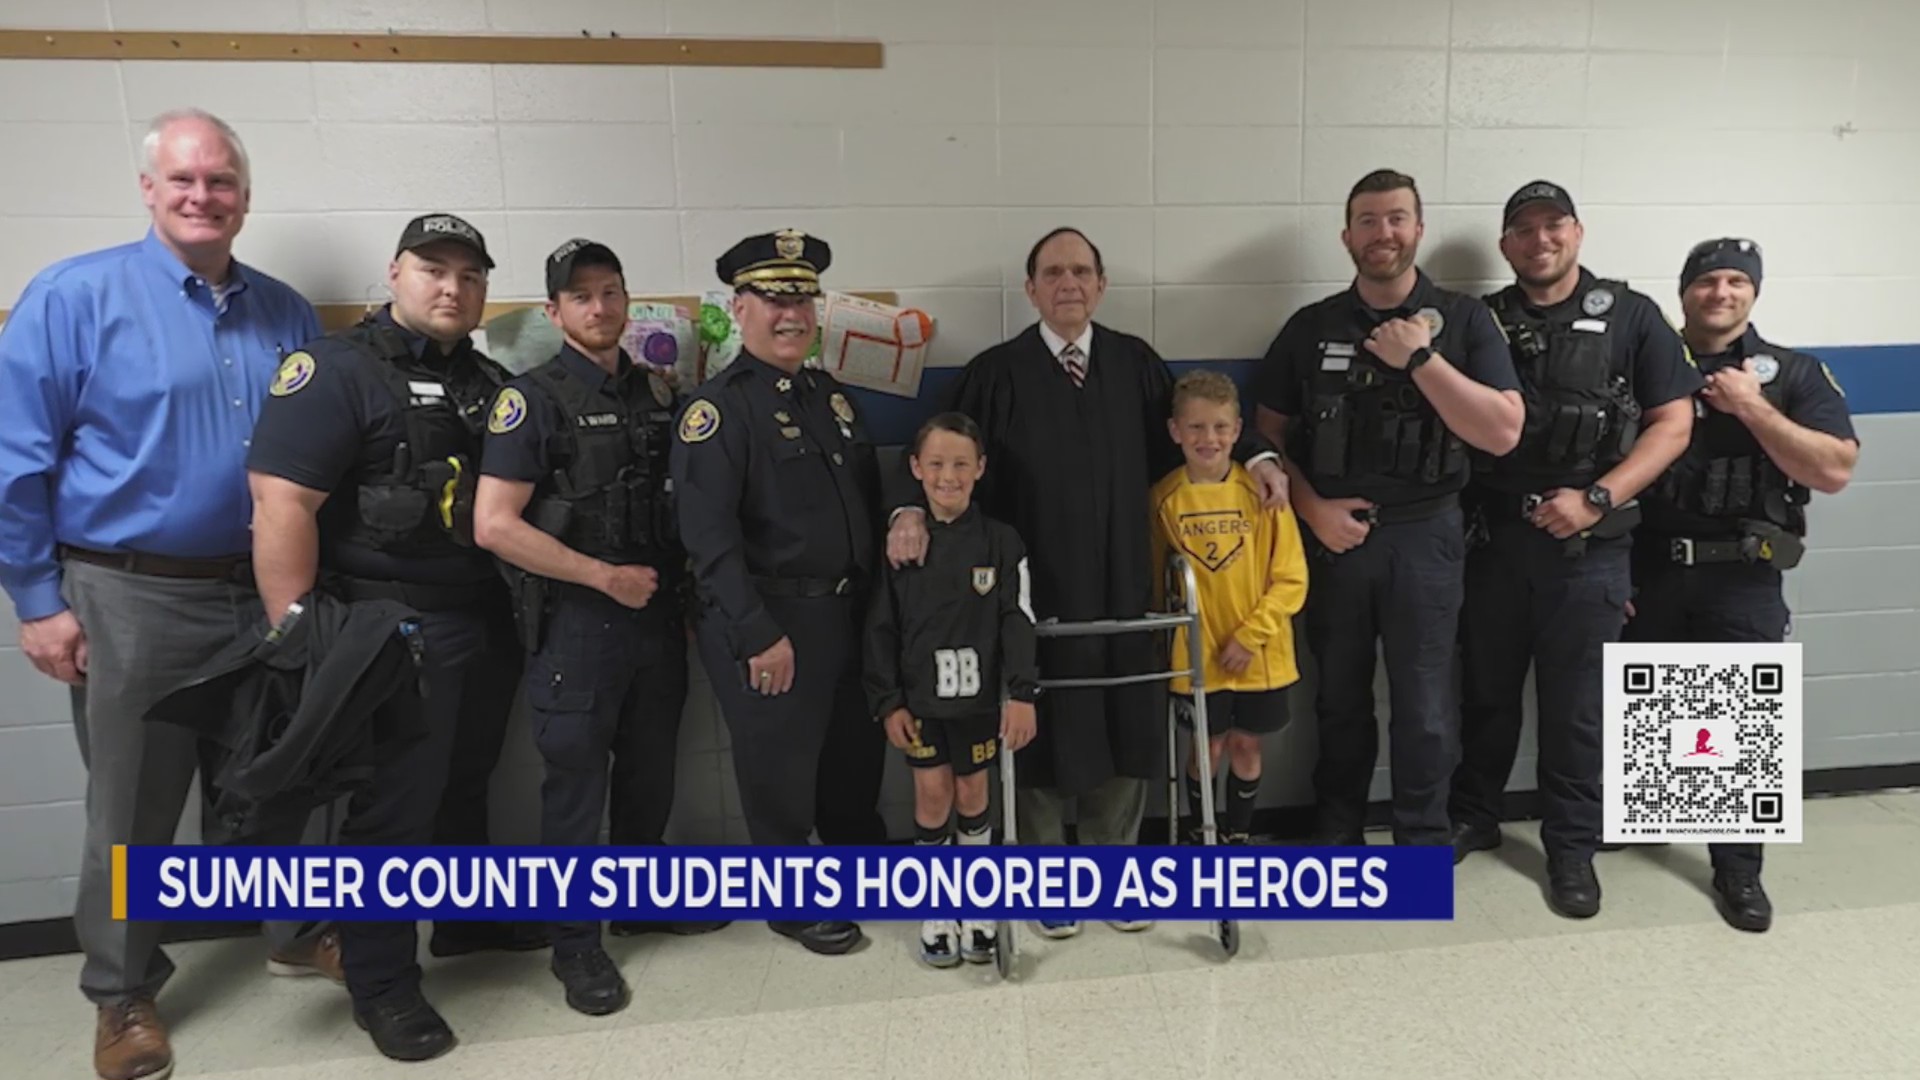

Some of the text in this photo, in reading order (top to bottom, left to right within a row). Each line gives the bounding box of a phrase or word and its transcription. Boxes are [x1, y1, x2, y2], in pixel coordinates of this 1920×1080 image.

[1175, 519, 1252, 537] ANGERS
[1205, 541, 1218, 561] 2
[978, 573, 988, 586] H
[934, 647, 981, 698] BB
[972, 738, 997, 765] BB
